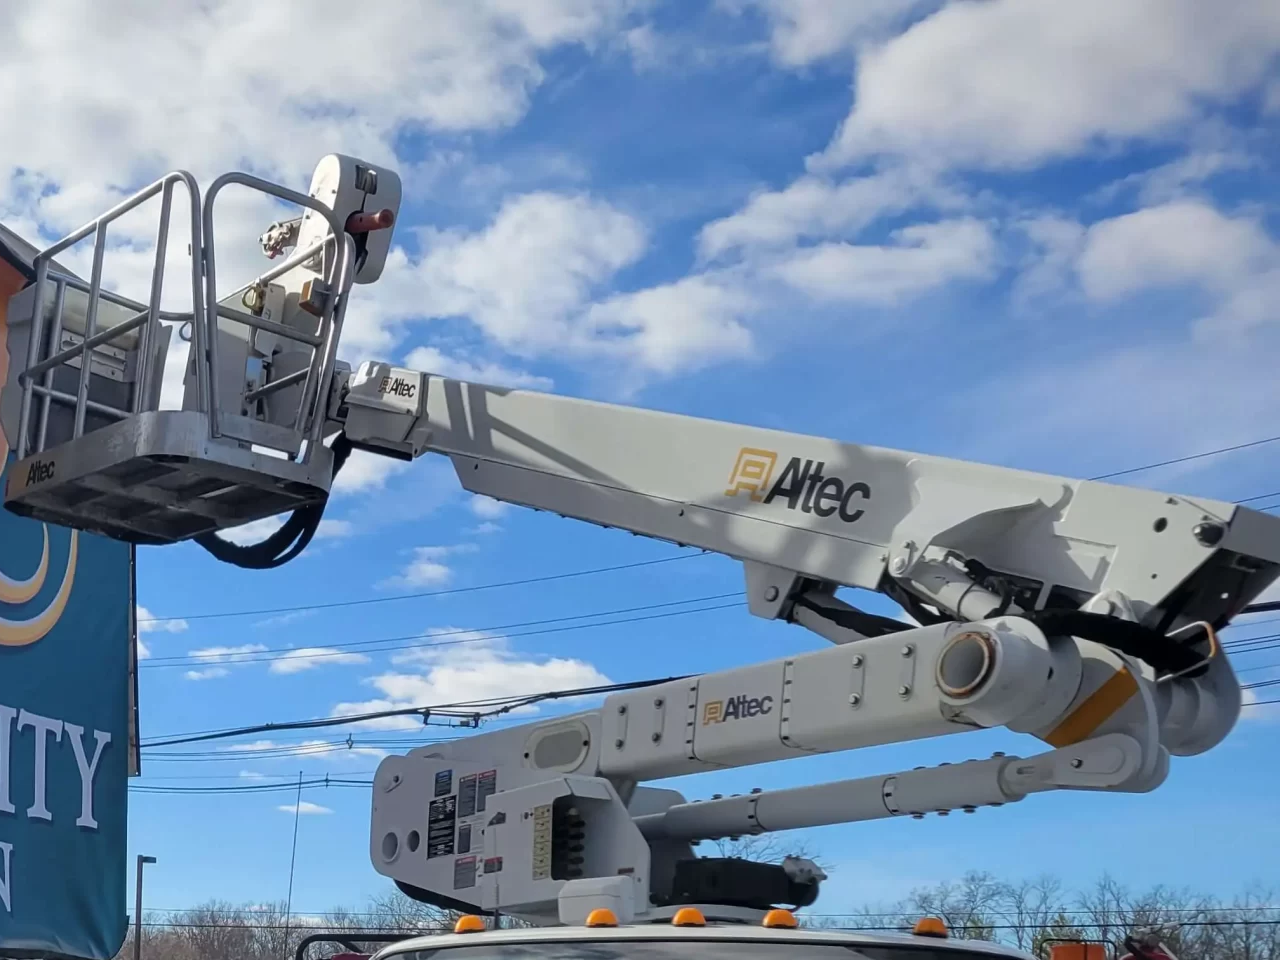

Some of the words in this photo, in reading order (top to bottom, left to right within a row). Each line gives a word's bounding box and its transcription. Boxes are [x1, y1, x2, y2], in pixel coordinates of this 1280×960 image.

[388, 377, 416, 398] Altec
[25, 459, 56, 488] Altec
[763, 456, 871, 523] Altec
[722, 694, 774, 722] Altec
